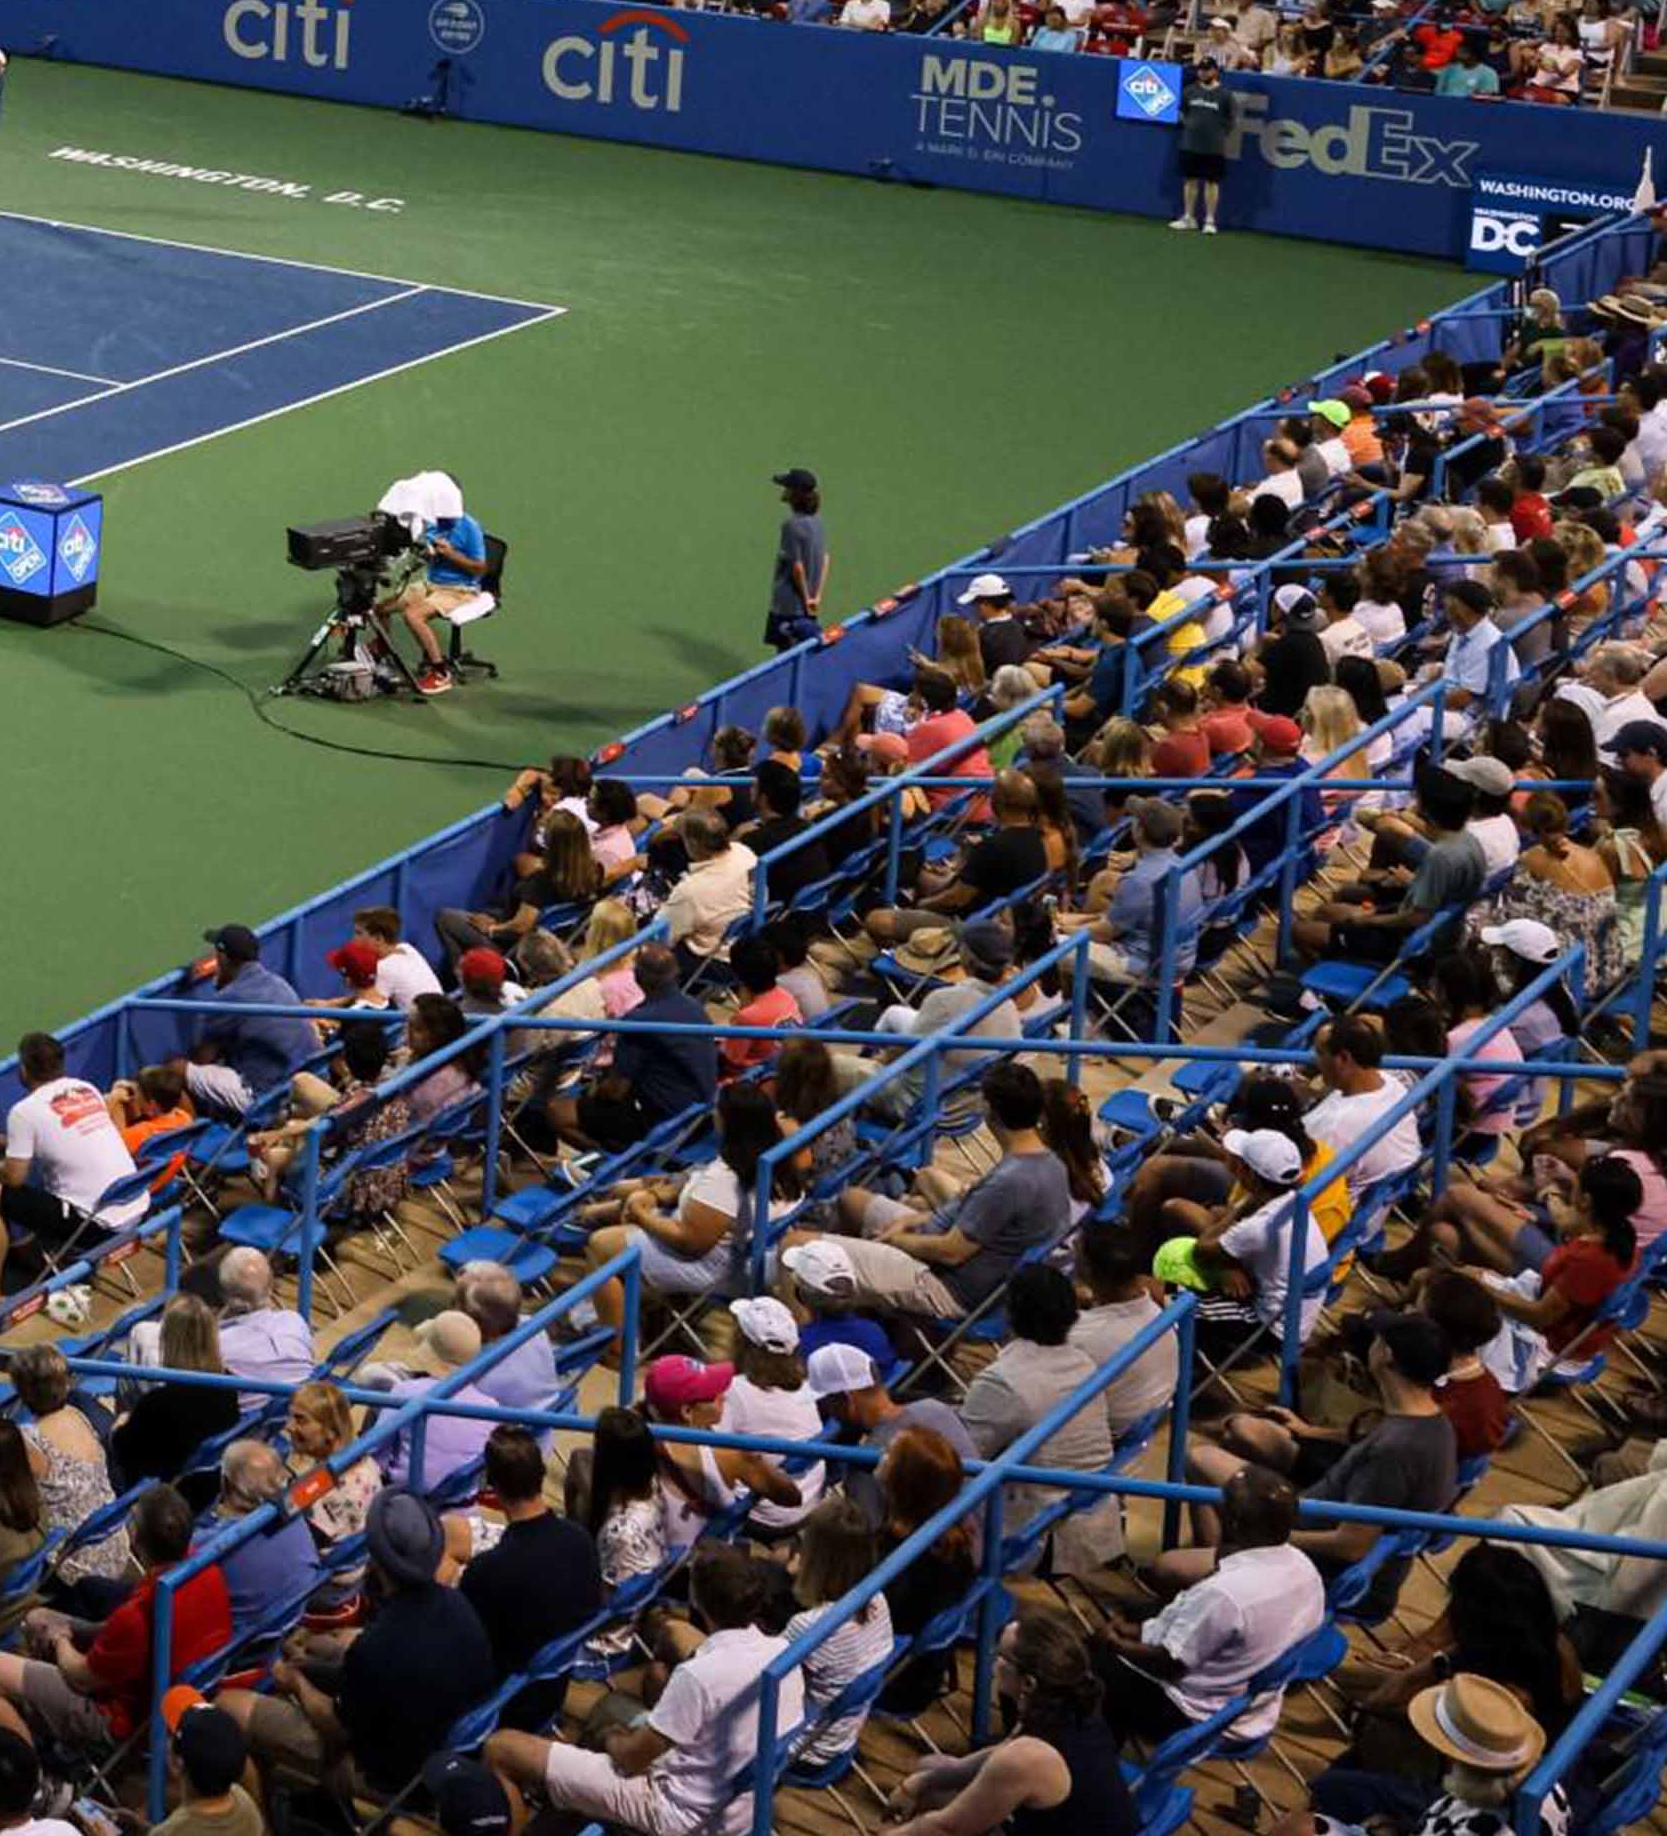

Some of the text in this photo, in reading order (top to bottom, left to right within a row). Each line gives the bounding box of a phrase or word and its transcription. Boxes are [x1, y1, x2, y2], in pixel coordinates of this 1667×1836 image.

[542, 18, 685, 112] citi
[921, 54, 1057, 108] MDE.
[911, 93, 1083, 153] TENNIS
[1224, 91, 1479, 188] FedEx
[323, 190, 407, 213] D.C.
[1470, 215, 1540, 257] DC
